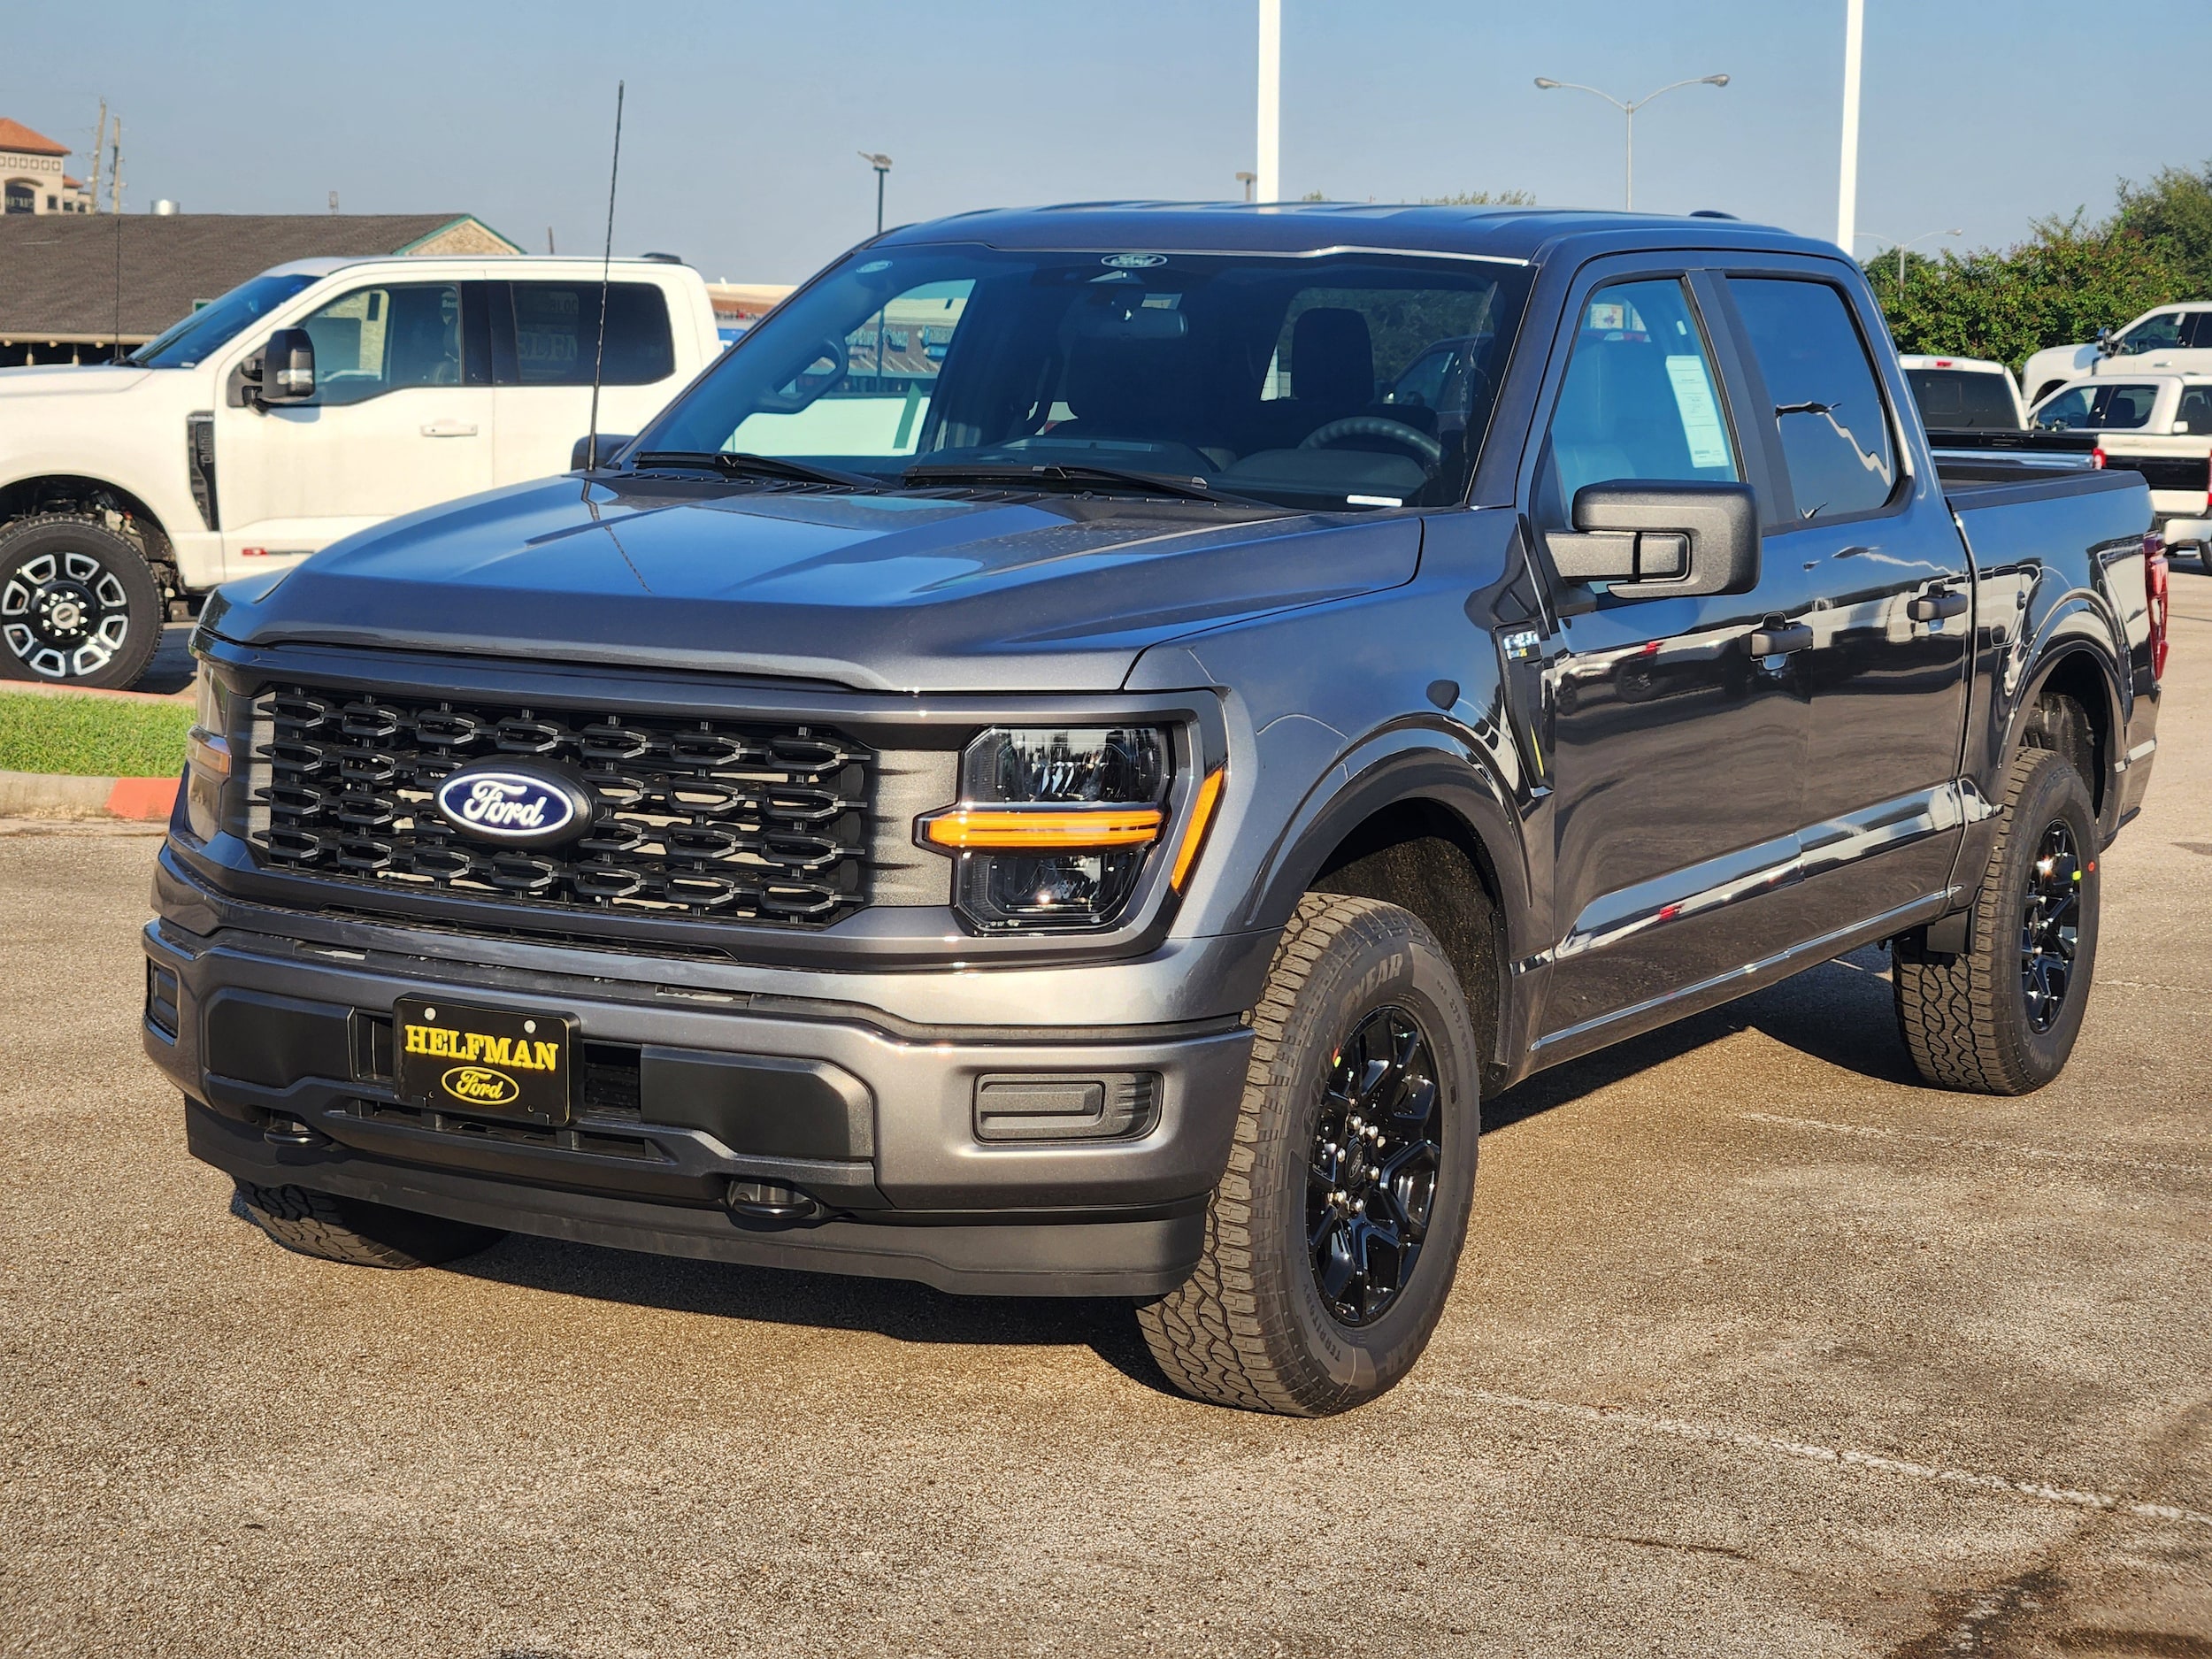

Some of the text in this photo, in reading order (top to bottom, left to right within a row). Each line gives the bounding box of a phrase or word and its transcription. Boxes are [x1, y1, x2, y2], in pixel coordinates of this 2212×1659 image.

[463, 780, 547, 827] Ford
[403, 1024, 560, 1071] HELFMAN
[455, 1069, 505, 1100] Ford
